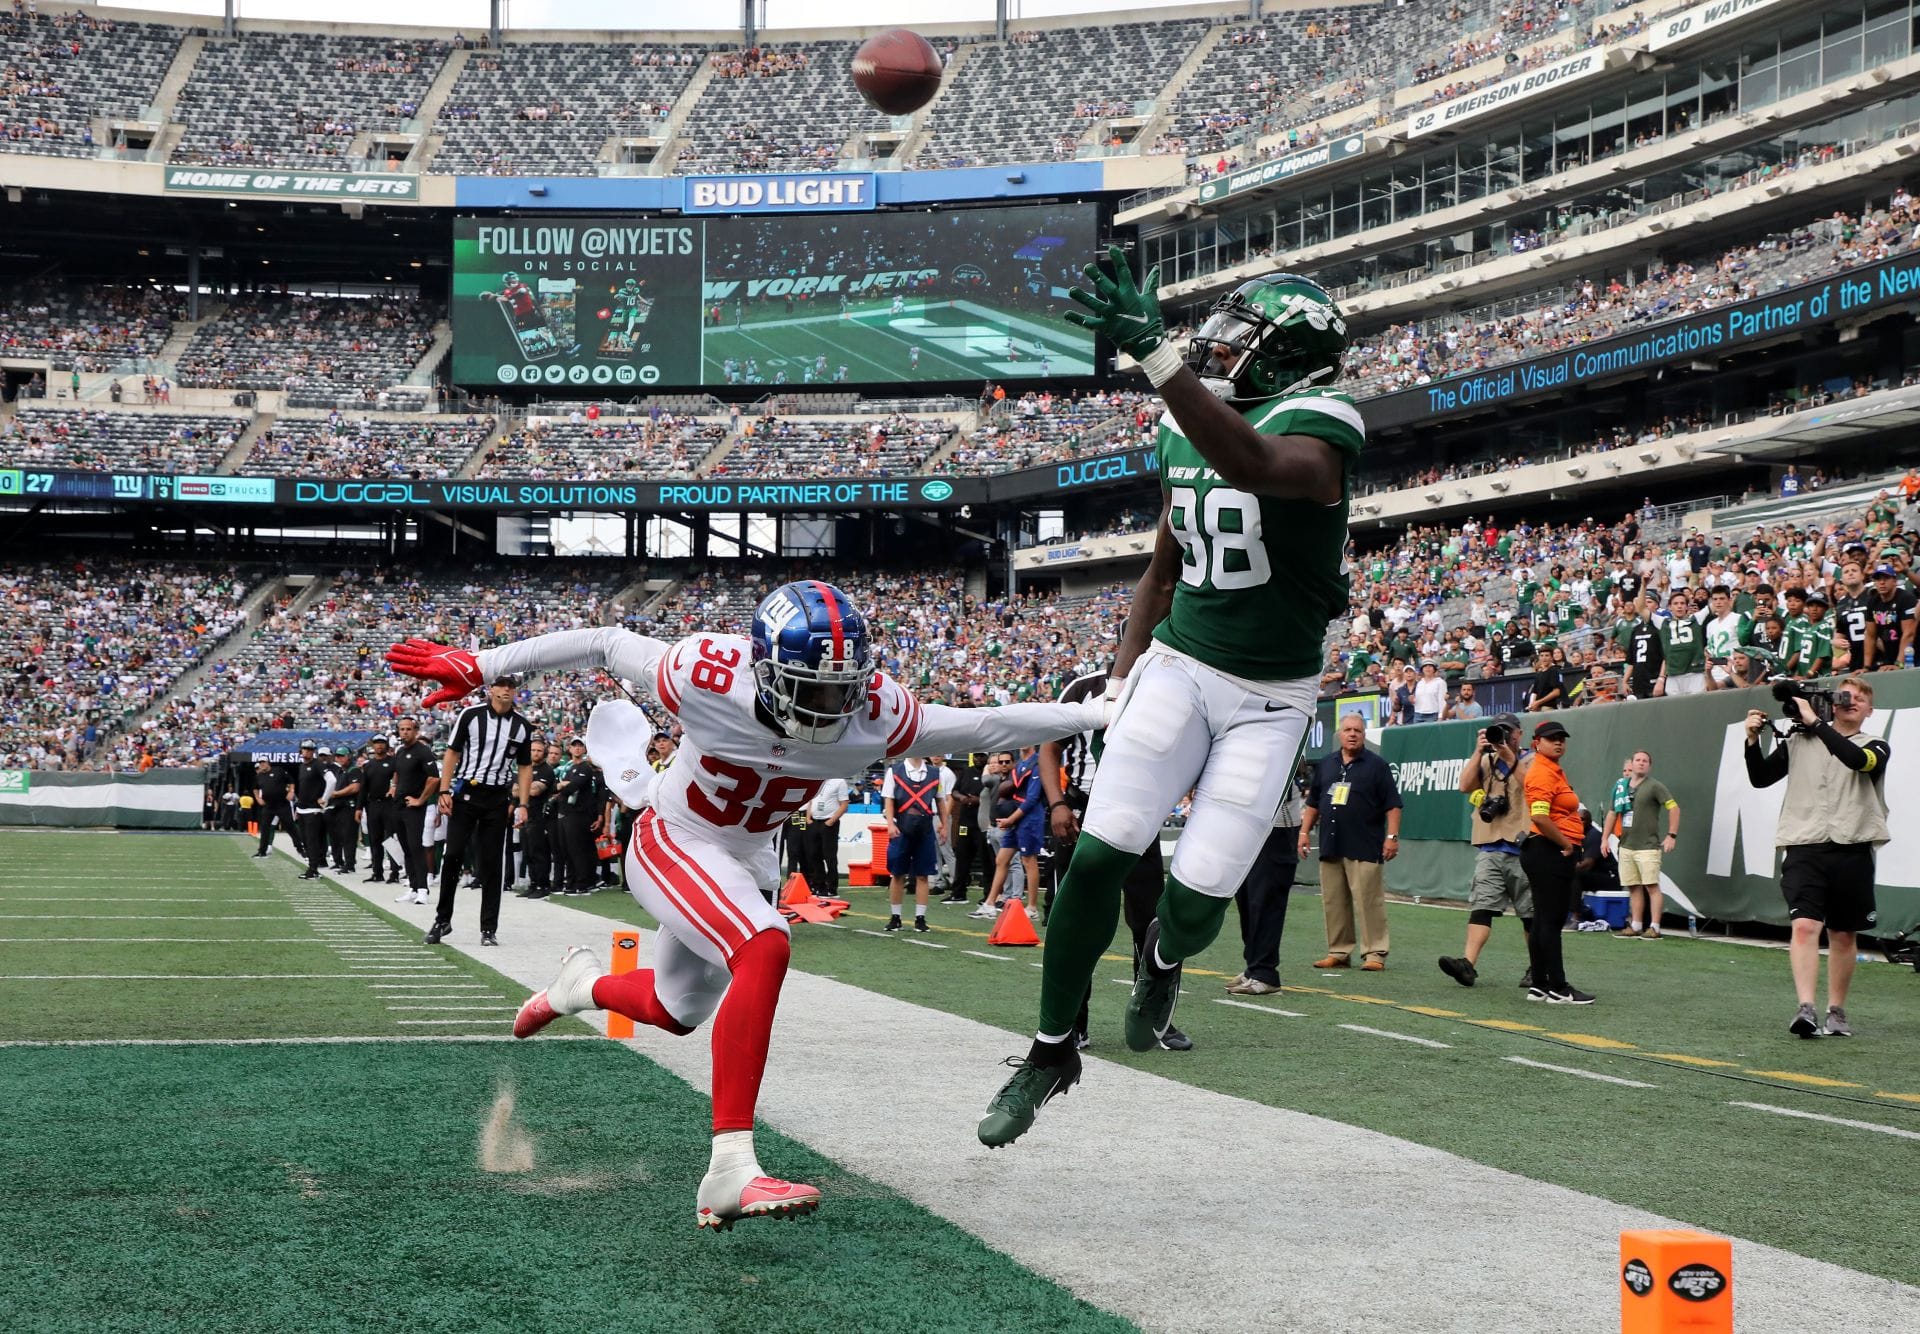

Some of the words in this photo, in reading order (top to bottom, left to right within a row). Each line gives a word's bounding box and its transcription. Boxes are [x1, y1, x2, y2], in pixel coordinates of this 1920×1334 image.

[1667, 17, 1691, 38] 80
[1415, 113, 1436, 130] 32
[1444, 82, 1521, 120] EMERSON
[1523, 56, 1592, 91] BOOZER
[1230, 170, 1262, 190] RING
[1262, 163, 1281, 179] OF
[1280, 148, 1329, 174] HONOR
[169, 172, 250, 188] HOME
[252, 175, 290, 190] OF
[293, 177, 343, 192] THE
[346, 179, 412, 195] JETS
[693, 181, 763, 207] BUD
[767, 179, 864, 205] LIGHT
[478, 226, 574, 256] FOLLOW
[581, 227, 693, 258] @NYJETS
[524, 261, 548, 271] ON
[563, 260, 637, 271] SOCIAL
[747, 275, 846, 297] YORK
[1428, 386, 1456, 412] The
[1459, 371, 1514, 405] Official
[1520, 356, 1568, 391] Visual
[1574, 323, 1722, 377] Communications
[1730, 301, 1804, 339] Partner
[1810, 285, 1831, 318] of
[1840, 280, 1872, 309] the
[26, 473, 54, 492] 27
[154, 476, 173, 486] TOL
[1167, 466, 1200, 480] NEW
[159, 486, 169, 498] 3
[228, 486, 268, 495] TRUCKS
[442, 486, 514, 503] VISUAL
[519, 486, 637, 504] SOLUTIONS
[659, 486, 731, 504] PROUD
[737, 485, 831, 503] PARTNER
[834, 484, 863, 502] OF
[868, 483, 909, 501] THE
[1669, 620, 1694, 645] 15
[1847, 612, 1866, 642] 2
[821, 639, 854, 660] 38
[1636, 639, 1648, 663] 2
[691, 638, 741, 695] 38
[686, 755, 824, 834] 38
[1673, 1277, 1721, 1290] JETS
